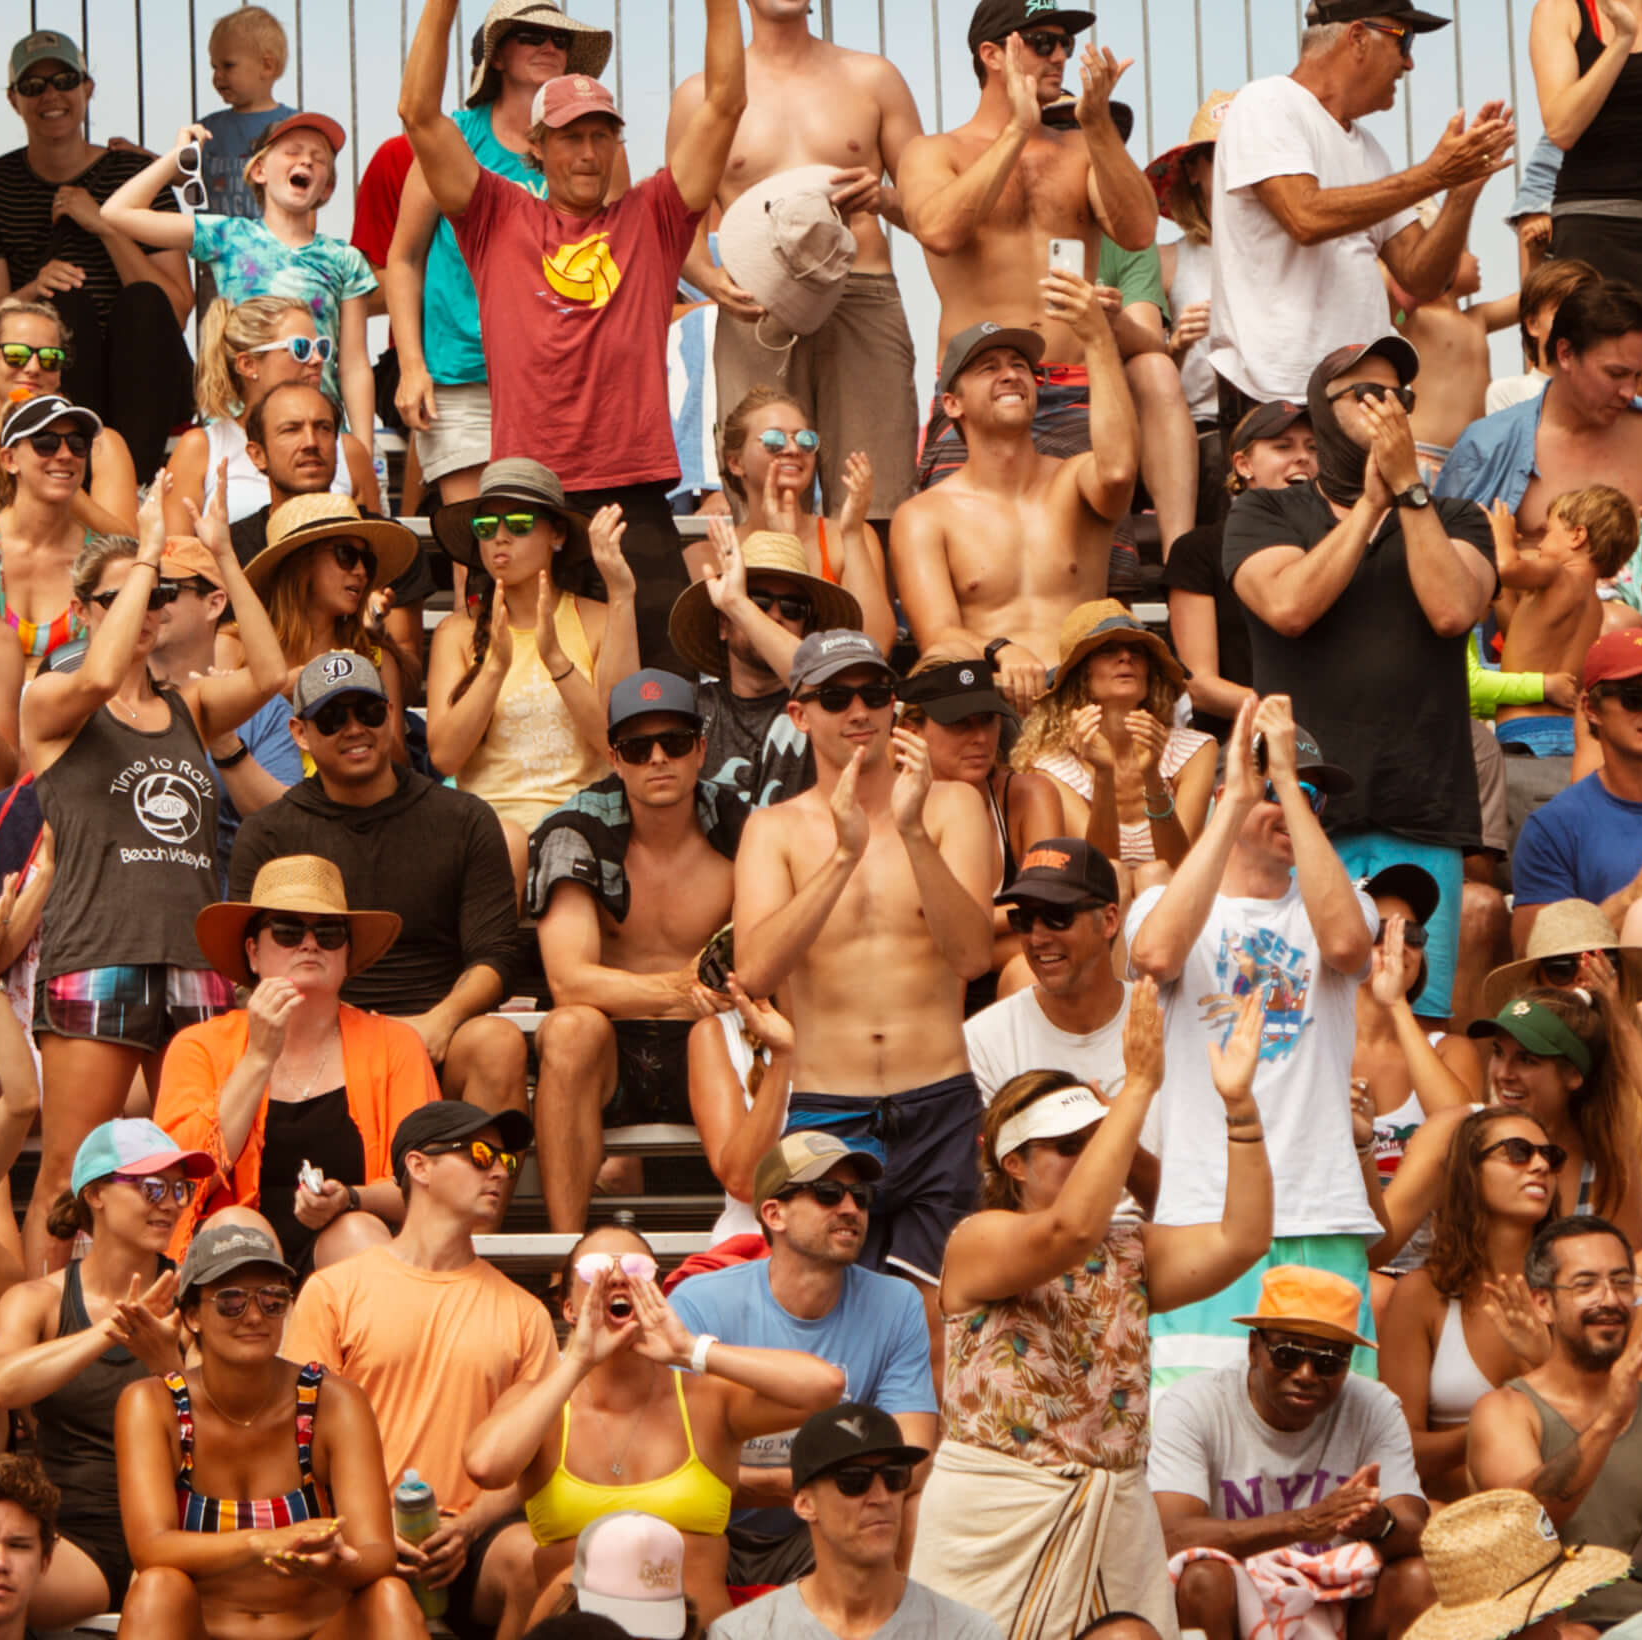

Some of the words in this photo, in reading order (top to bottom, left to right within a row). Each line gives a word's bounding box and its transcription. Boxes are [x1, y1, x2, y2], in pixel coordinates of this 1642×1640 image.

[110, 761, 147, 796] Time
[150, 755, 173, 770] to
[178, 759, 215, 801] Rally
[119, 845, 167, 864] Beach
[1257, 927, 1306, 971] SET
[746, 1438, 775, 1451] BIG
